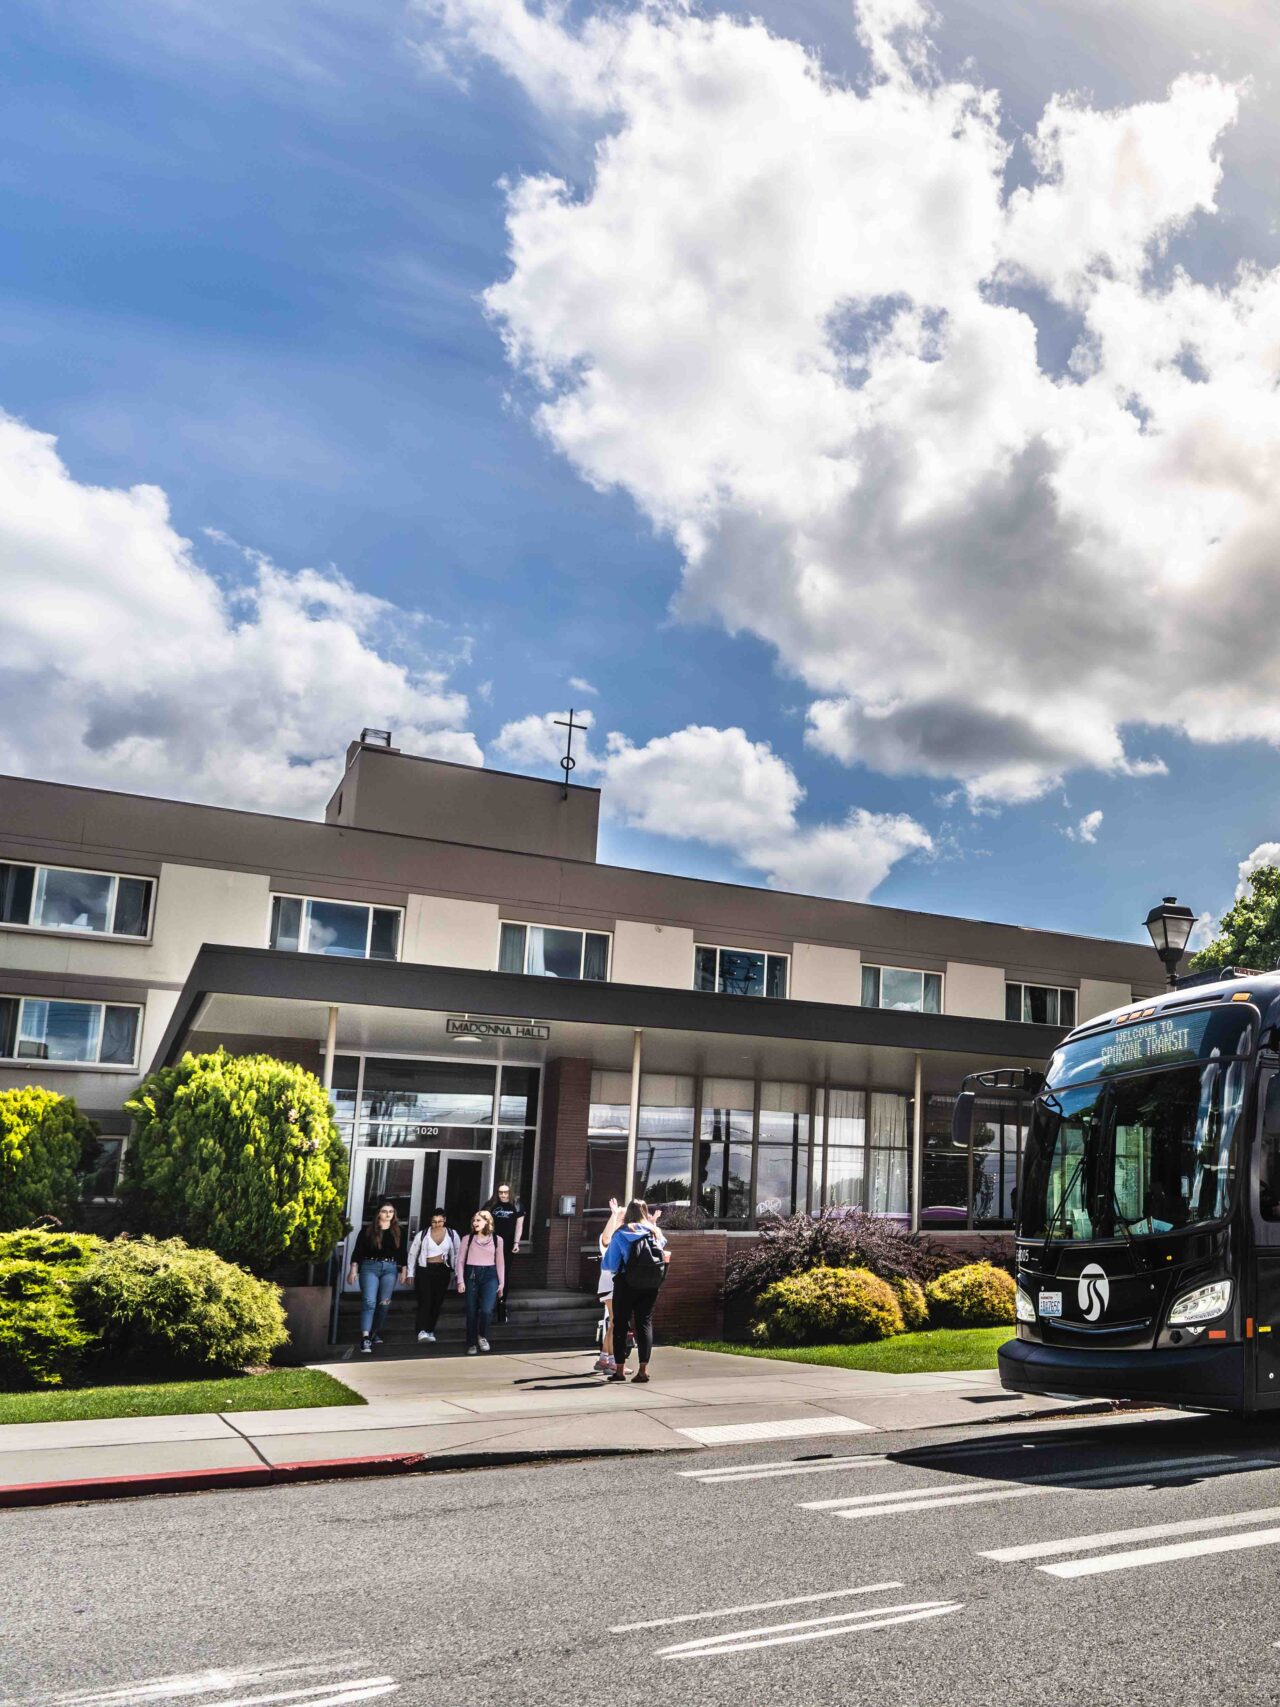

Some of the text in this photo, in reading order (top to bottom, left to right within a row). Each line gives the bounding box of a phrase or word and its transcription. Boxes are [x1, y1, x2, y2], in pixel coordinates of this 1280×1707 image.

[451, 1022, 545, 1038] MADONNA HALL
[1115, 1020, 1174, 1044] WELCOME TO
[1101, 1028, 1190, 1066] SPOKANE TRANSIT
[415, 1127, 439, 1135] 1020
